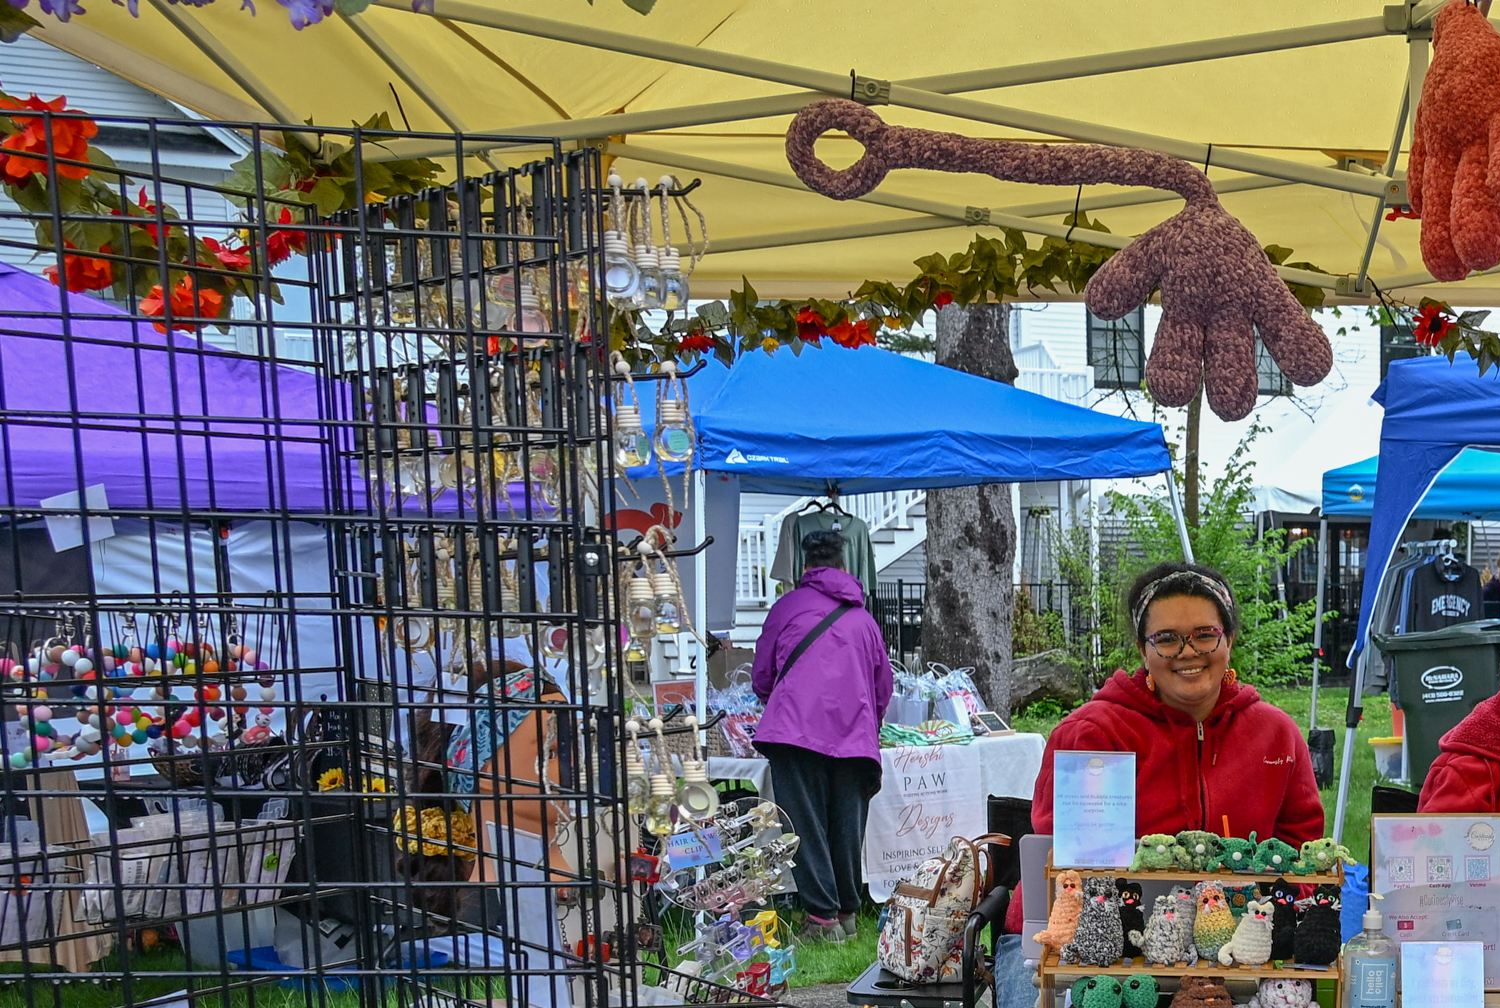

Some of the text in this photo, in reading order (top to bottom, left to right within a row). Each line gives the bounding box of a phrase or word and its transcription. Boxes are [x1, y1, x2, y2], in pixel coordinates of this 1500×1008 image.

[903, 772, 946, 791] PAW
[895, 803, 955, 839] Designs
[668, 839, 689, 848] HAIR
[882, 849, 926, 861] INSPIRING
[890, 864, 913, 873] LOVE
[1366, 970, 1375, 994] hello
